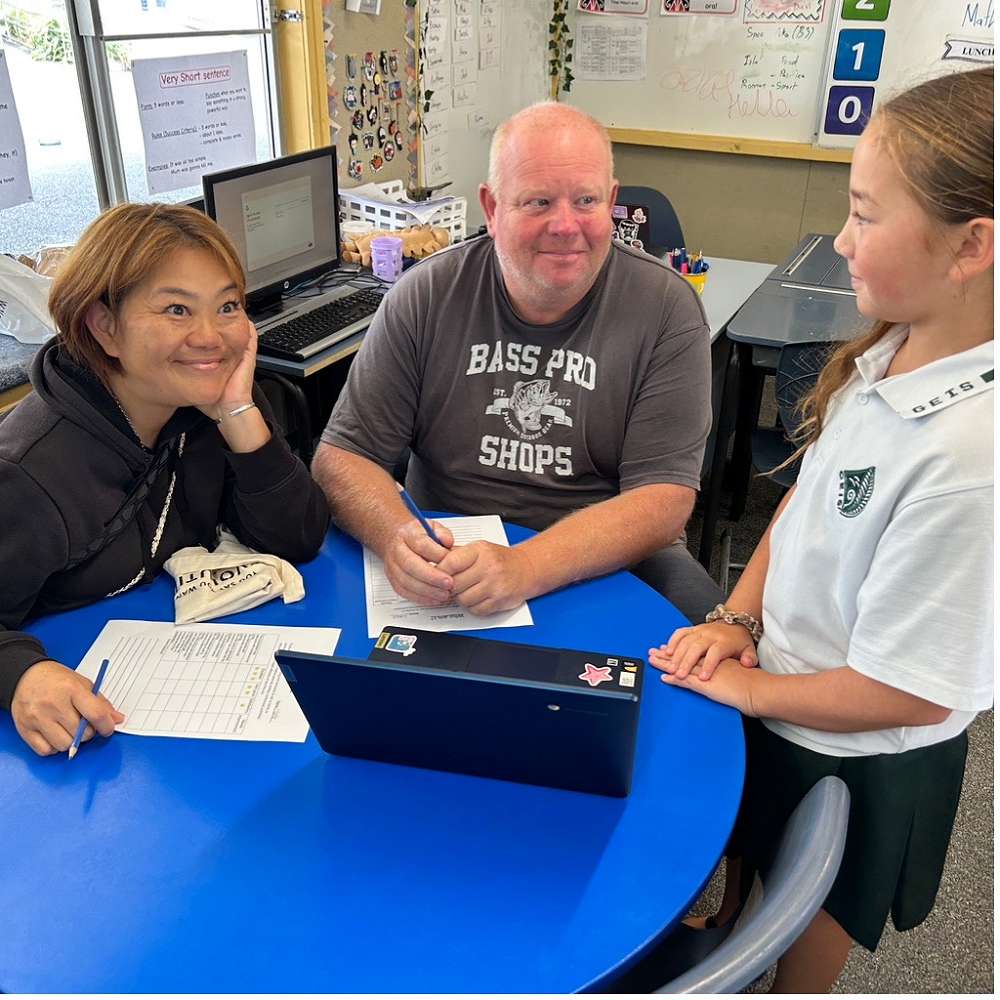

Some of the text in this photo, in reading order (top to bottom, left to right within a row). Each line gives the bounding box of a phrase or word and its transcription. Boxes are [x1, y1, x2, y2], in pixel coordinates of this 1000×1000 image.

[852, 42, 865, 71] 1
[160, 69, 230, 84] Very Short sentence
[838, 95, 862, 124] 0
[466, 341, 597, 391] BASS PRO
[912, 381, 974, 414] GEIS
[478, 435, 573, 477] SHOPS
